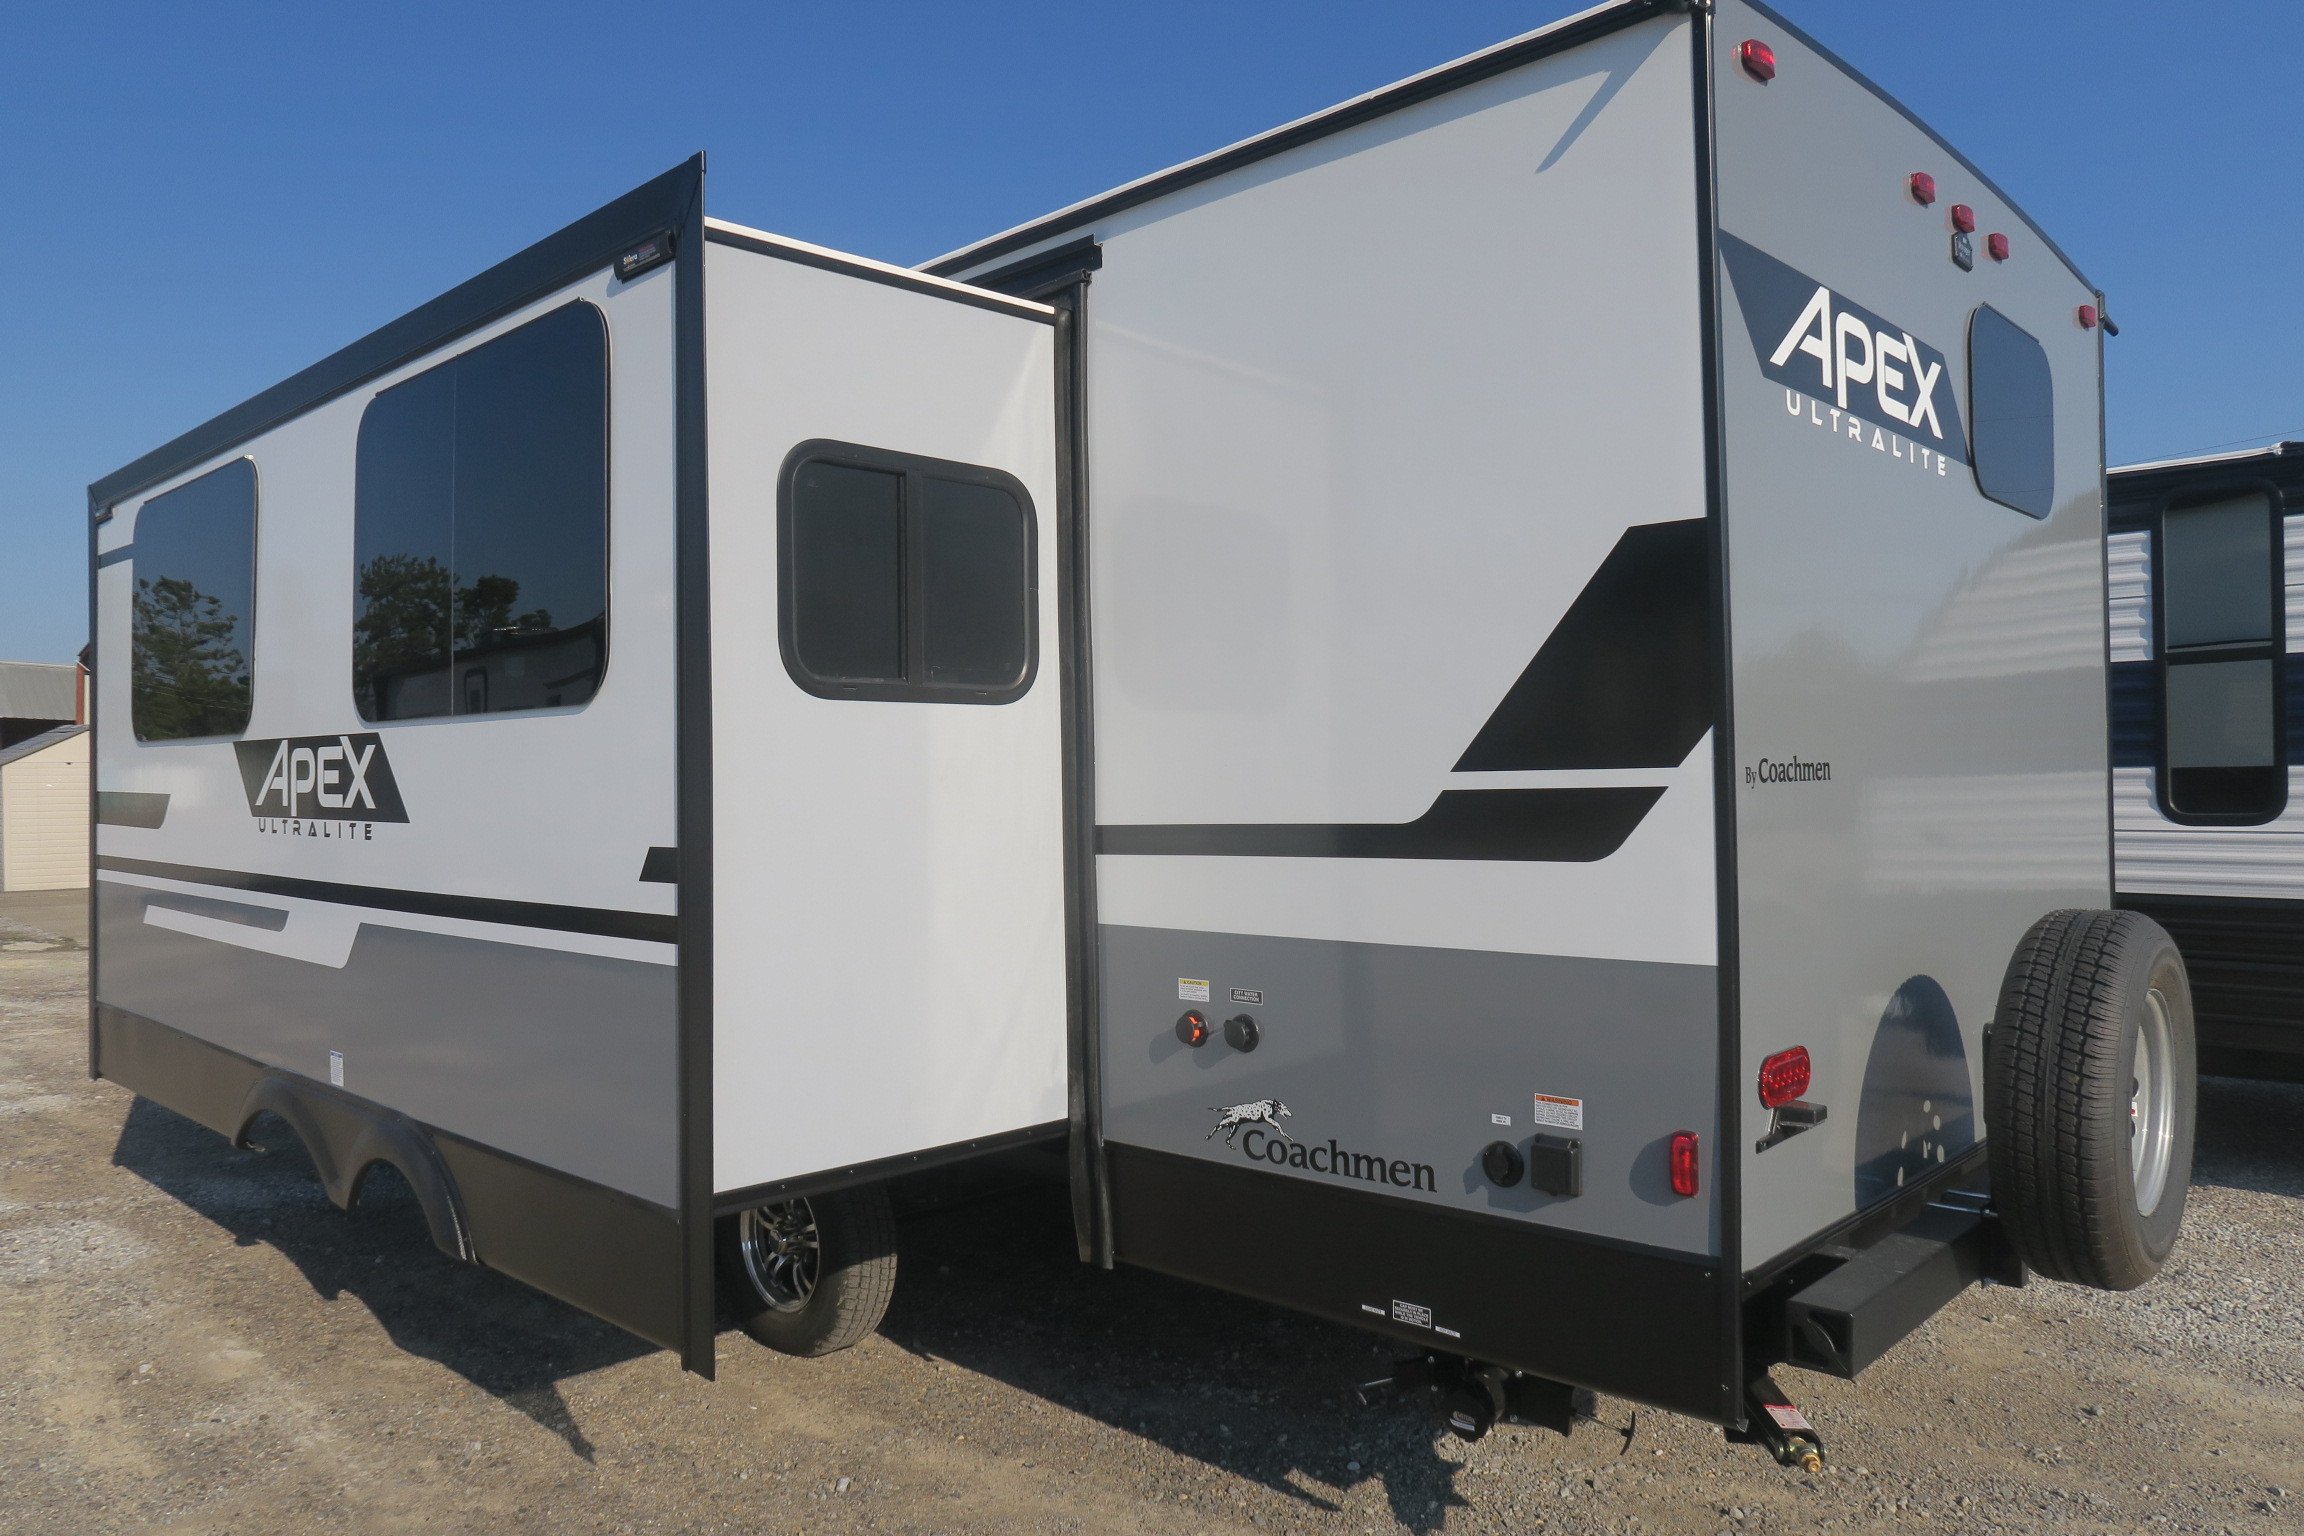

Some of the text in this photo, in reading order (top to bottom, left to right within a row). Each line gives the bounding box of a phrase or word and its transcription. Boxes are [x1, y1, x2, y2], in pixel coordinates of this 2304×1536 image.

[1769, 285, 1944, 440] APEX
[1786, 388, 1947, 477] ULTRALITE
[254, 735, 377, 817] APEX
[1745, 766, 1757, 790] By
[1758, 755, 1832, 783] Coachmen
[258, 818, 373, 841] ULTRALITE
[1242, 1129, 1438, 1193] Coachmen
